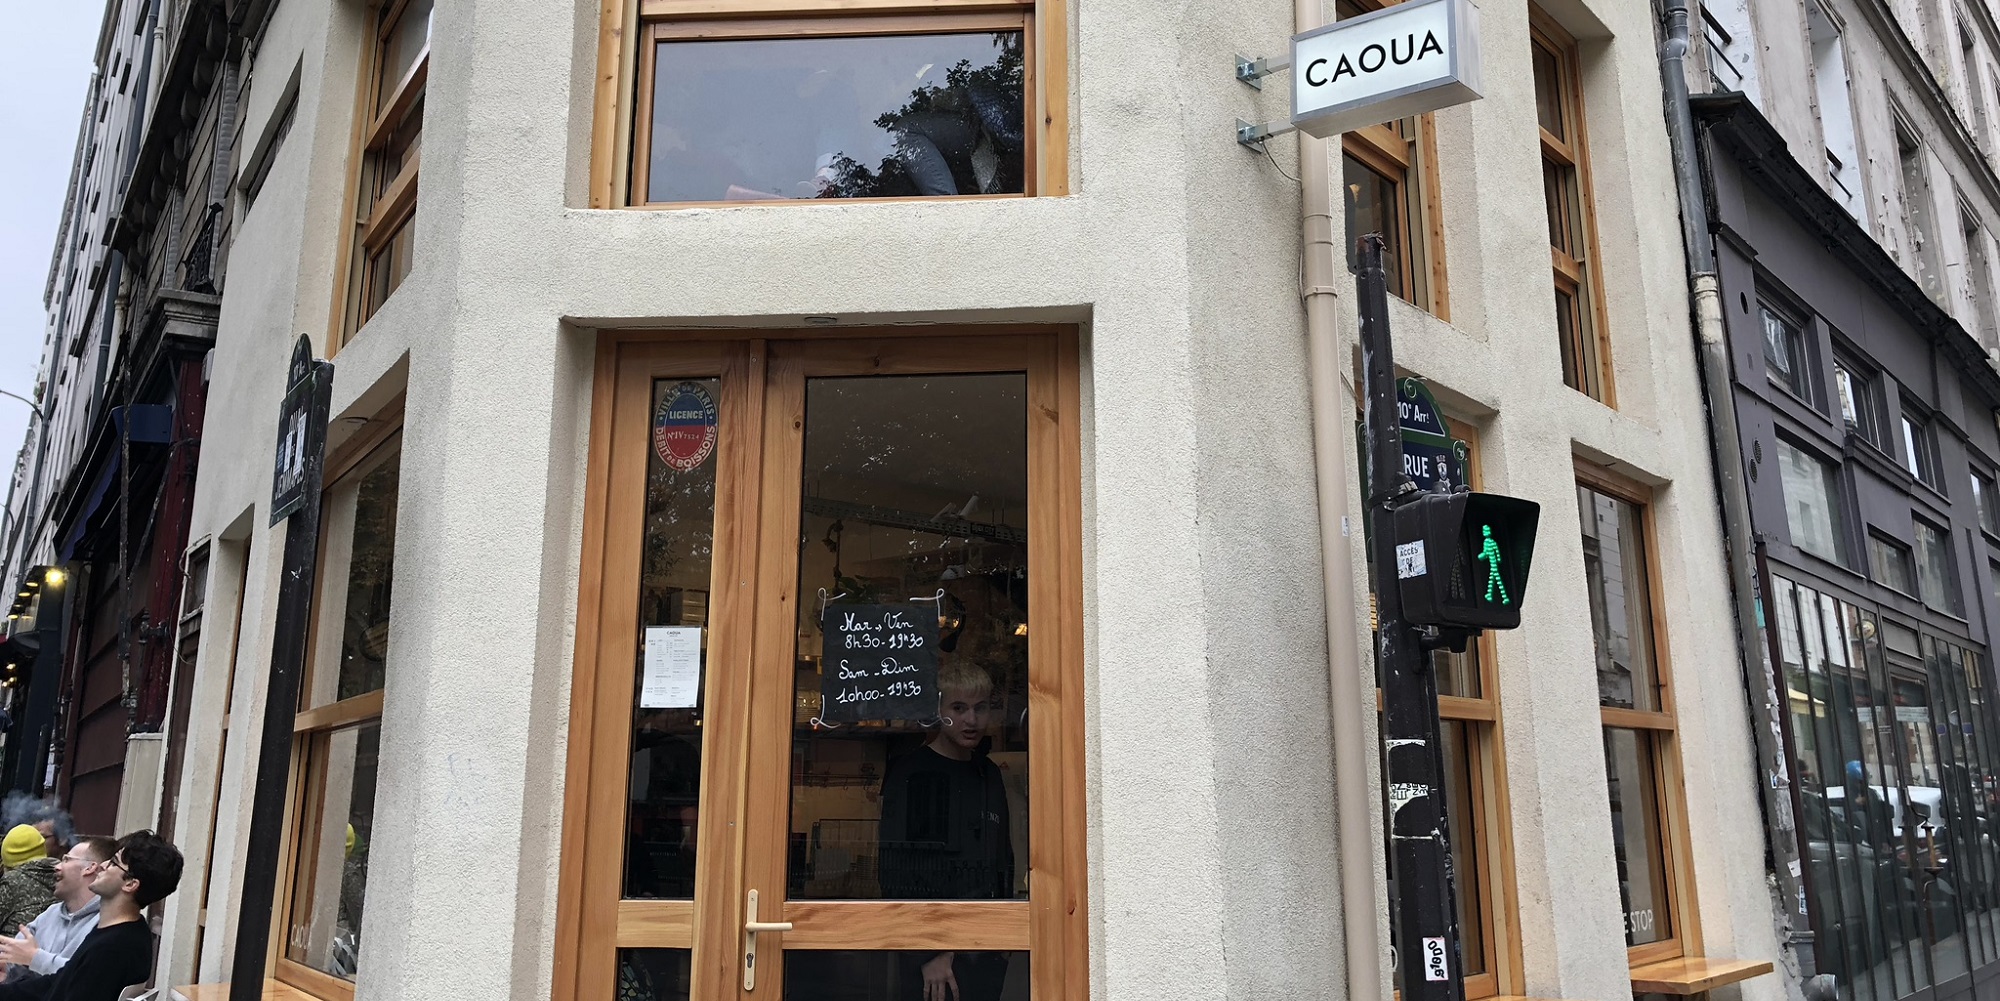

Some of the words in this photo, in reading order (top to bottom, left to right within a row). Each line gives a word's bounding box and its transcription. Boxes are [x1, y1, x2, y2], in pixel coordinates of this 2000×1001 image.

[1306, 29, 1444, 87] CAOUA
[658, 388, 680, 416] VILLE
[692, 386, 714, 415] PARIS
[669, 410, 703, 419] LICENCE
[656, 427, 671, 457] DEBIT
[676, 426, 716, 468] BOISSONS
[1403, 453, 1430, 478] RUE
[839, 612, 873, 632] Mar
[883, 611, 914, 630] Ven
[838, 659, 869, 680] Sam
[880, 656, 919, 676] Dim
[1630, 909, 1654, 932] STOP
